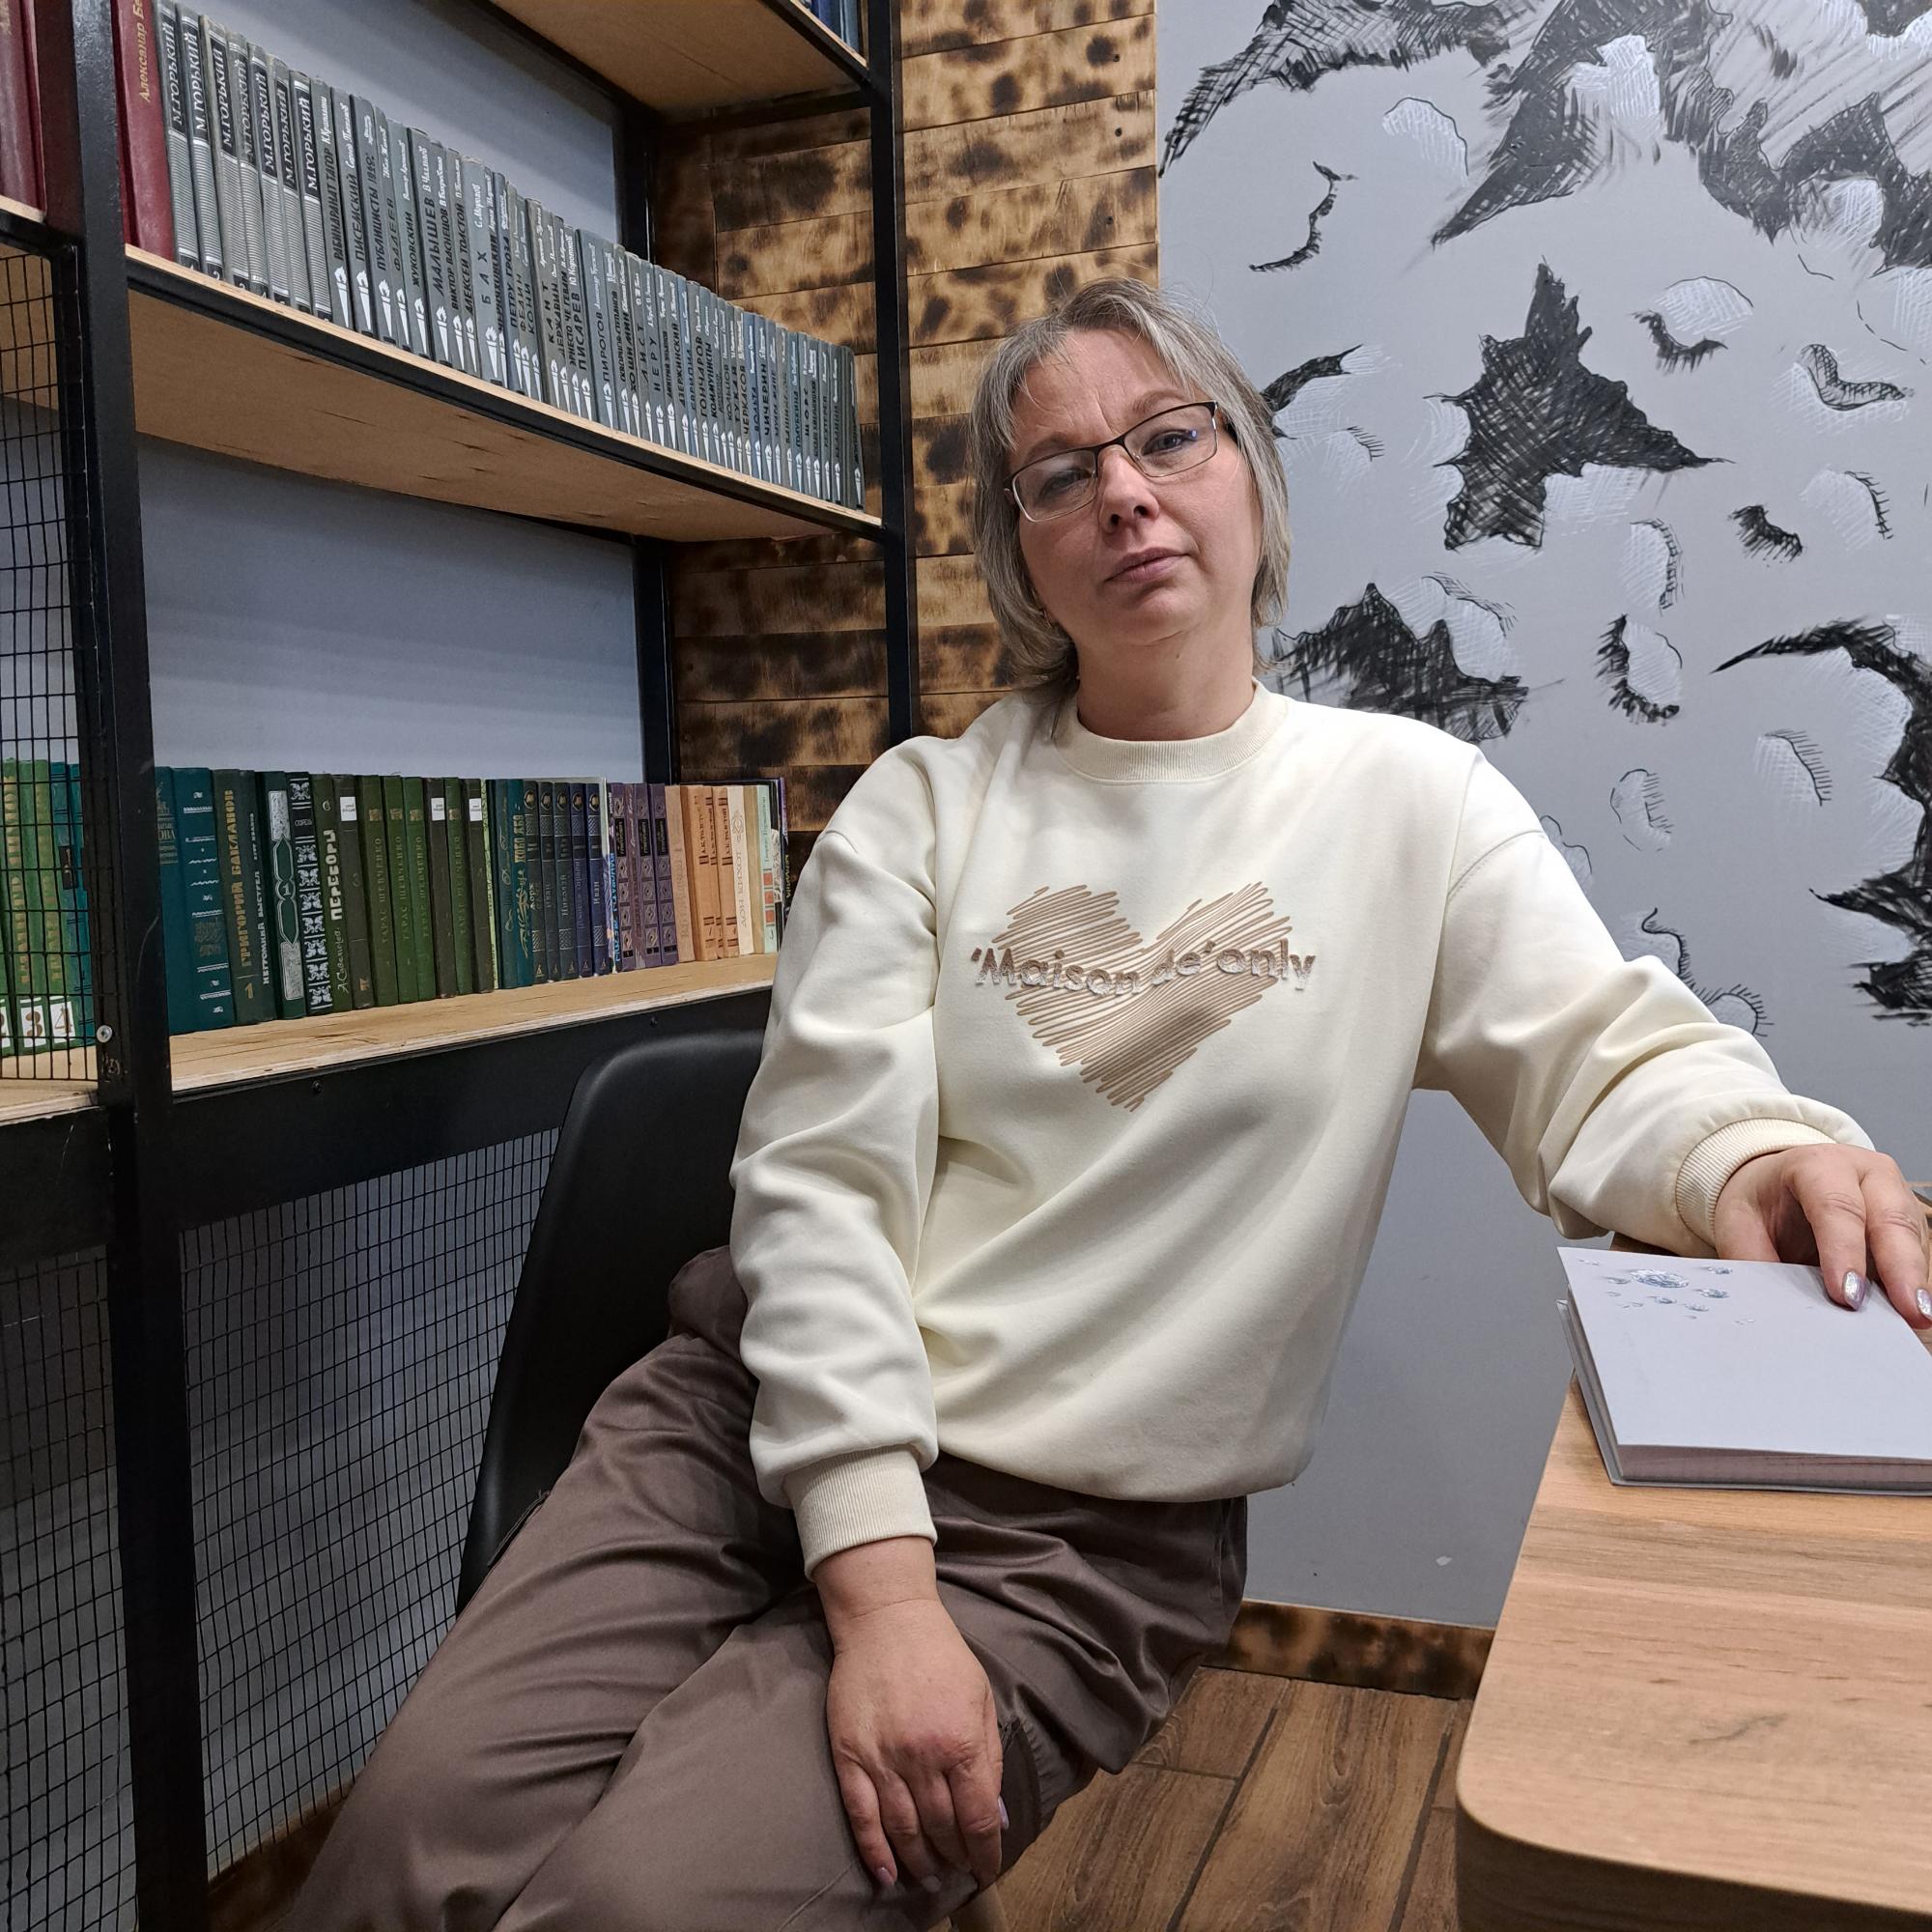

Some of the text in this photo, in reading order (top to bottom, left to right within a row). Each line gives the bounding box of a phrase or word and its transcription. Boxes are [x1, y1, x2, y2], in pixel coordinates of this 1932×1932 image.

[137, 22, 151, 102] Александр
[347, 174, 365, 262] ПИСЕМСКИЙ
[368, 186, 386, 271] ПУБЛИЦИСТЫ
[423, 196, 444, 297] МАЛЫШЕВ
[502, 235, 512, 278] ГРОЗА
[446, 268, 459, 310] ВИКТОР
[506, 282, 518, 328] ПЕТРУ
[525, 282, 535, 335] КОНИ
[552, 283, 565, 357] ДЕРЖАВИН
[571, 292, 587, 371] ПИСАРЕВ
[596, 311, 611, 383] ПИРОГОВ
[671, 322, 686, 408] ДЗЕРЖИНСКИЙ
[696, 335, 707, 418] ГОНЧАРОВ
[705, 341, 718, 418] КОММУНИСТЫ
[740, 365, 750, 435] ЧЕРКАСОВ
[761, 363, 770, 436] ЧИЧЕРИН
[224, 789, 251, 967] ГРИГОРИЙ БАКЛАНОВ
[324, 829, 343, 921] ПЕРЕБОРЫ
[254, 870, 270, 984] НЕГРОМКИЙ ВЫСТРЕЛ
[25, 1010, 43, 1037] 3
[54, 1006, 72, 1034] 4
